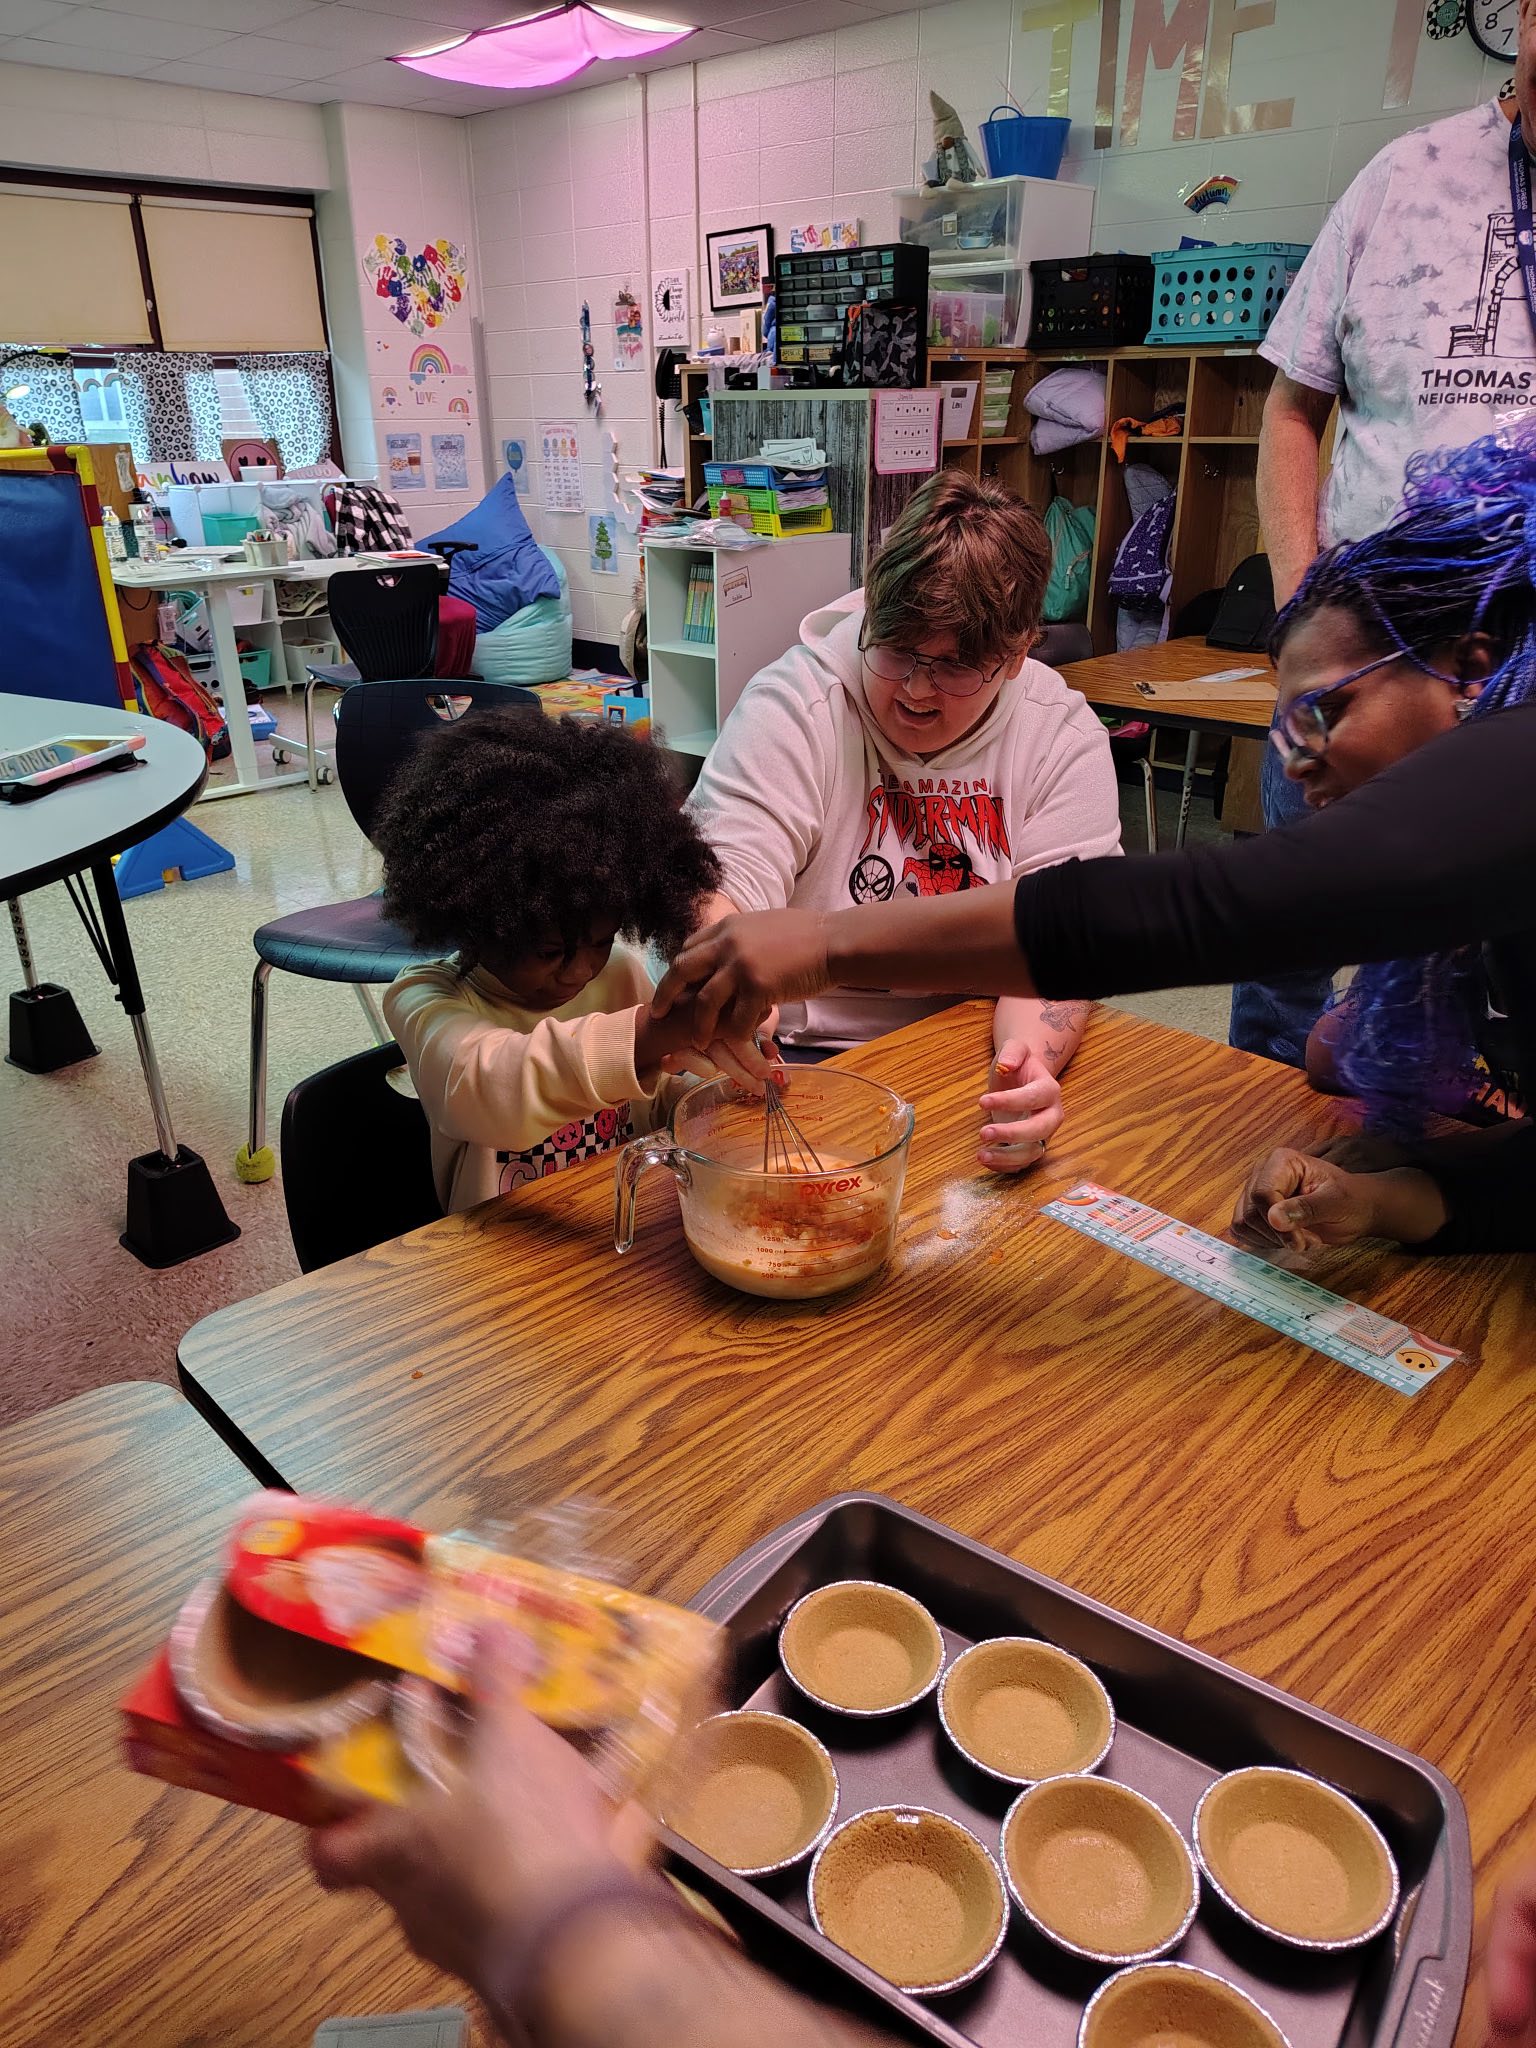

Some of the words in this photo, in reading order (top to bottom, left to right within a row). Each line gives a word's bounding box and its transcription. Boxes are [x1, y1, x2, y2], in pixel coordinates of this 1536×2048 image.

[1485, 12, 1497, 29] 8
[1502, 27, 1514, 46] 7
[1022, 0, 1295, 150] TIME
[1517, 158, 1526, 187] THOMAS
[1421, 368, 1532, 390] THOMAS
[903, 778, 992, 795] AMAZIN
[800, 1175, 862, 1201] pyrex
